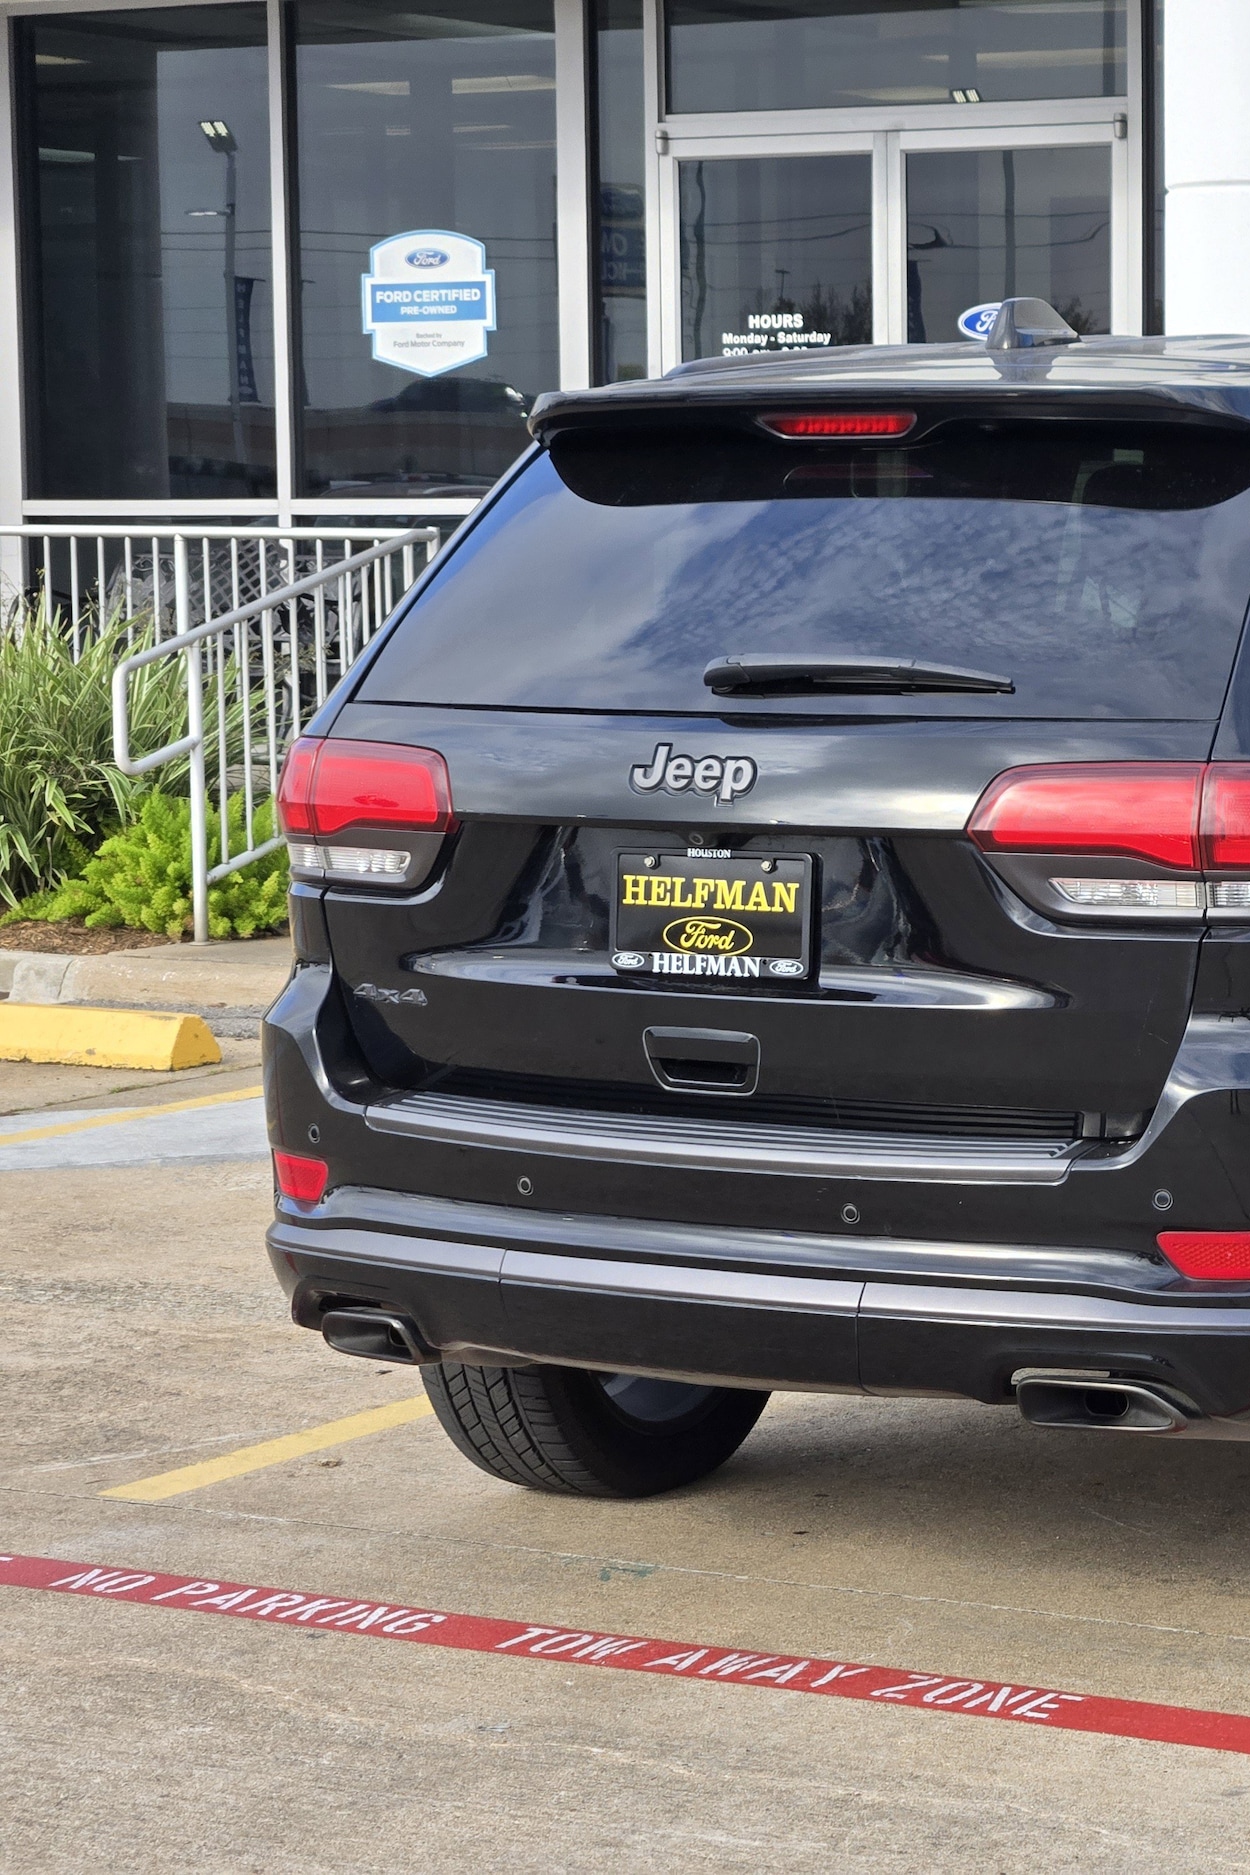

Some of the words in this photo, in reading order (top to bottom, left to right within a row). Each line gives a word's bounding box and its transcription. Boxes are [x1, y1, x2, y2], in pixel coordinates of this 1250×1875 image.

[413, 251, 442, 266] Ford
[376, 291, 412, 303] FORD
[413, 288, 481, 302] CERTIFIED
[400, 305, 458, 315] PRE-OWNED
[748, 314, 804, 329] HOURS
[410, 340, 431, 348] Motor
[432, 340, 466, 348] Company
[722, 332, 768, 347] Monday
[777, 331, 831, 345] Saturday
[630, 743, 757, 805] Jeep
[687, 848, 731, 859] HOUSTON
[622, 874, 800, 914] HELFMAN
[680, 920, 735, 951] Ford
[652, 952, 763, 978] HELFMAN
[774, 961, 799, 974] Ford
[49, 1568, 156, 1594] NO
[150, 1581, 447, 1635] PARKING
[495, 1627, 648, 1663] TOW
[648, 1648, 870, 1689] AWAY
[869, 1674, 1085, 1719] ZONE
